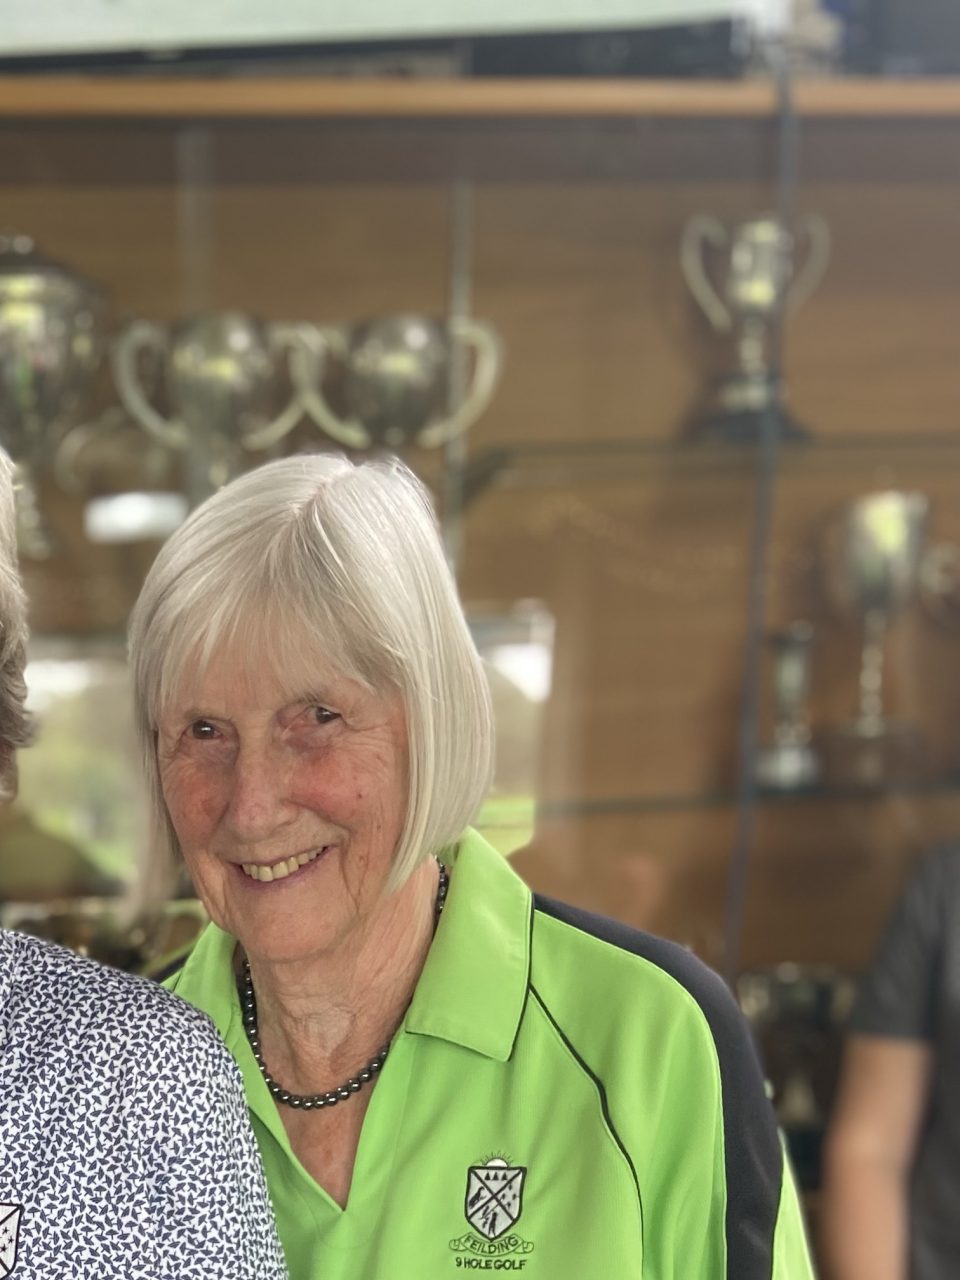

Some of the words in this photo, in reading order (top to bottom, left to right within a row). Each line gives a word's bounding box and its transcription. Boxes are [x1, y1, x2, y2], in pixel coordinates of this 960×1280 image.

[464, 1235, 519, 1254] FEILDING
[455, 1257, 462, 1267] 9
[464, 1257, 493, 1269] HOLE
[494, 1259, 528, 1270] GOLF
